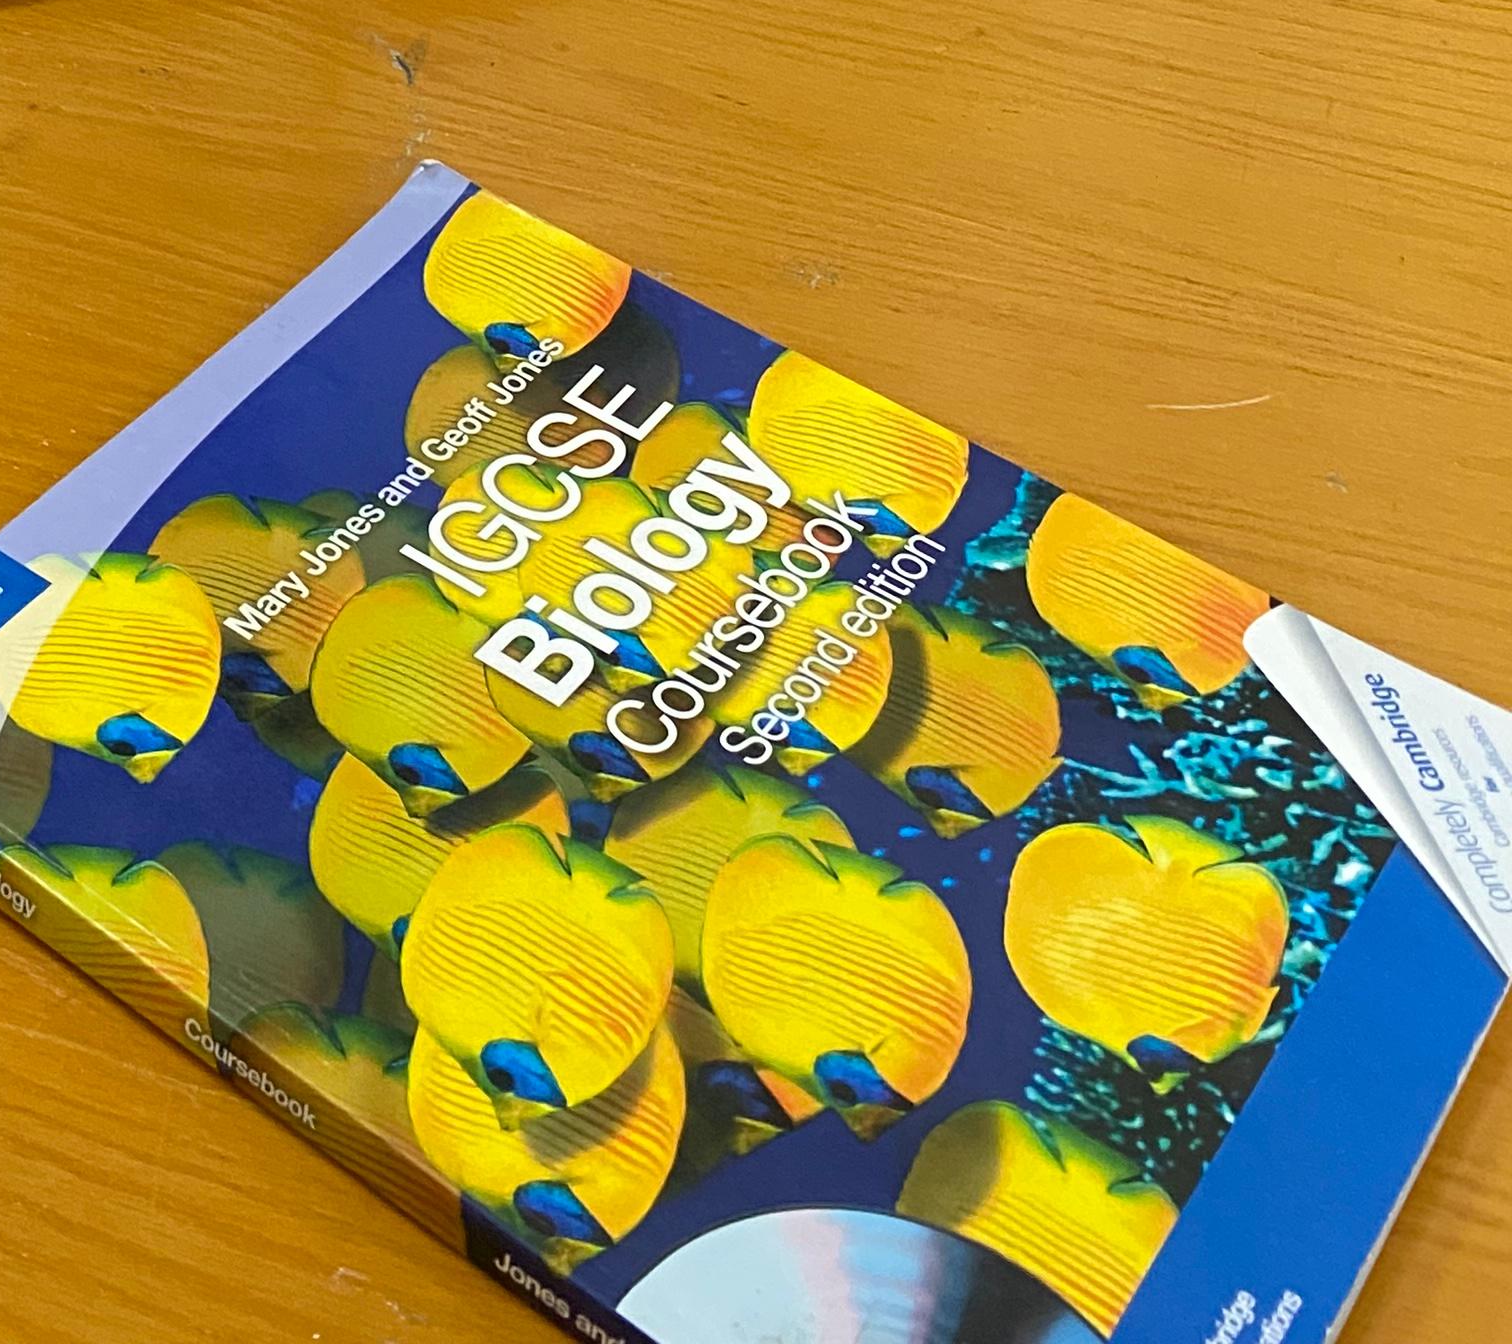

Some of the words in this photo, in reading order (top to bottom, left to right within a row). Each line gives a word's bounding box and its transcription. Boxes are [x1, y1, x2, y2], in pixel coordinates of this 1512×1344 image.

[224, 571, 307, 641] Mary
[304, 501, 386, 576] Jones
[377, 458, 435, 508] and
[422, 395, 496, 464] Geoff
[487, 336, 565, 409] Jones
[399, 364, 674, 598] IGCSE
[474, 431, 794, 708] Biology
[605, 489, 879, 756] Coursebook
[719, 637, 858, 767] Second
[838, 533, 946, 639] edition
[1365, 673, 1445, 792] Cambridge
[1430, 724, 1472, 783] resources
[1481, 773, 1500, 796] for
[1434, 799, 1512, 915] Completely
[1461, 776, 1512, 851] Cambridge
[184, 1017, 317, 1130] Coursebook
[493, 1251, 572, 1323] Jones
